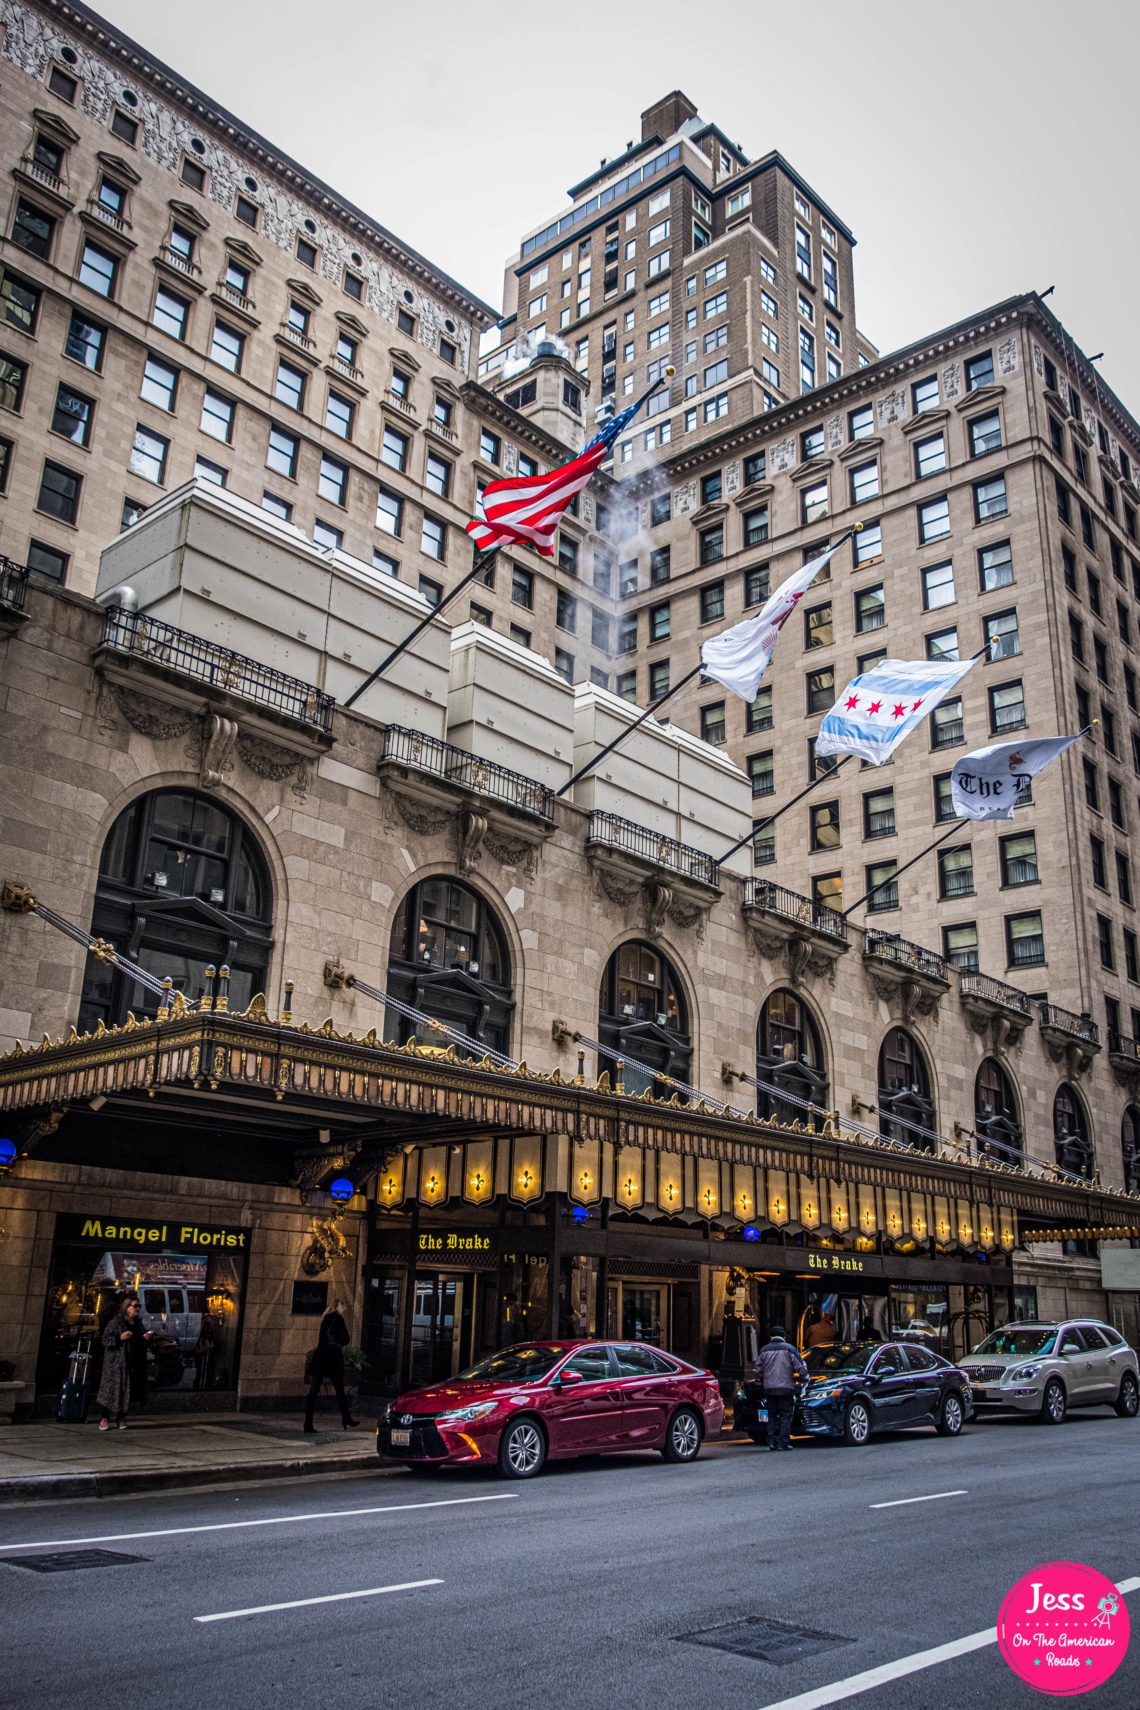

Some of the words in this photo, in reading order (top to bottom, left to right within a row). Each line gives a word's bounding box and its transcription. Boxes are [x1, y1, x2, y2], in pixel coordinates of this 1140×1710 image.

[958, 773, 1003, 798] The
[81, 1220, 167, 1244] Mangel
[180, 1227, 246, 1247] Florist
[419, 1234, 442, 1249] The
[446, 1234, 490, 1249] Drake
[808, 1254, 828, 1268] The
[832, 1256, 864, 1271] Drake
